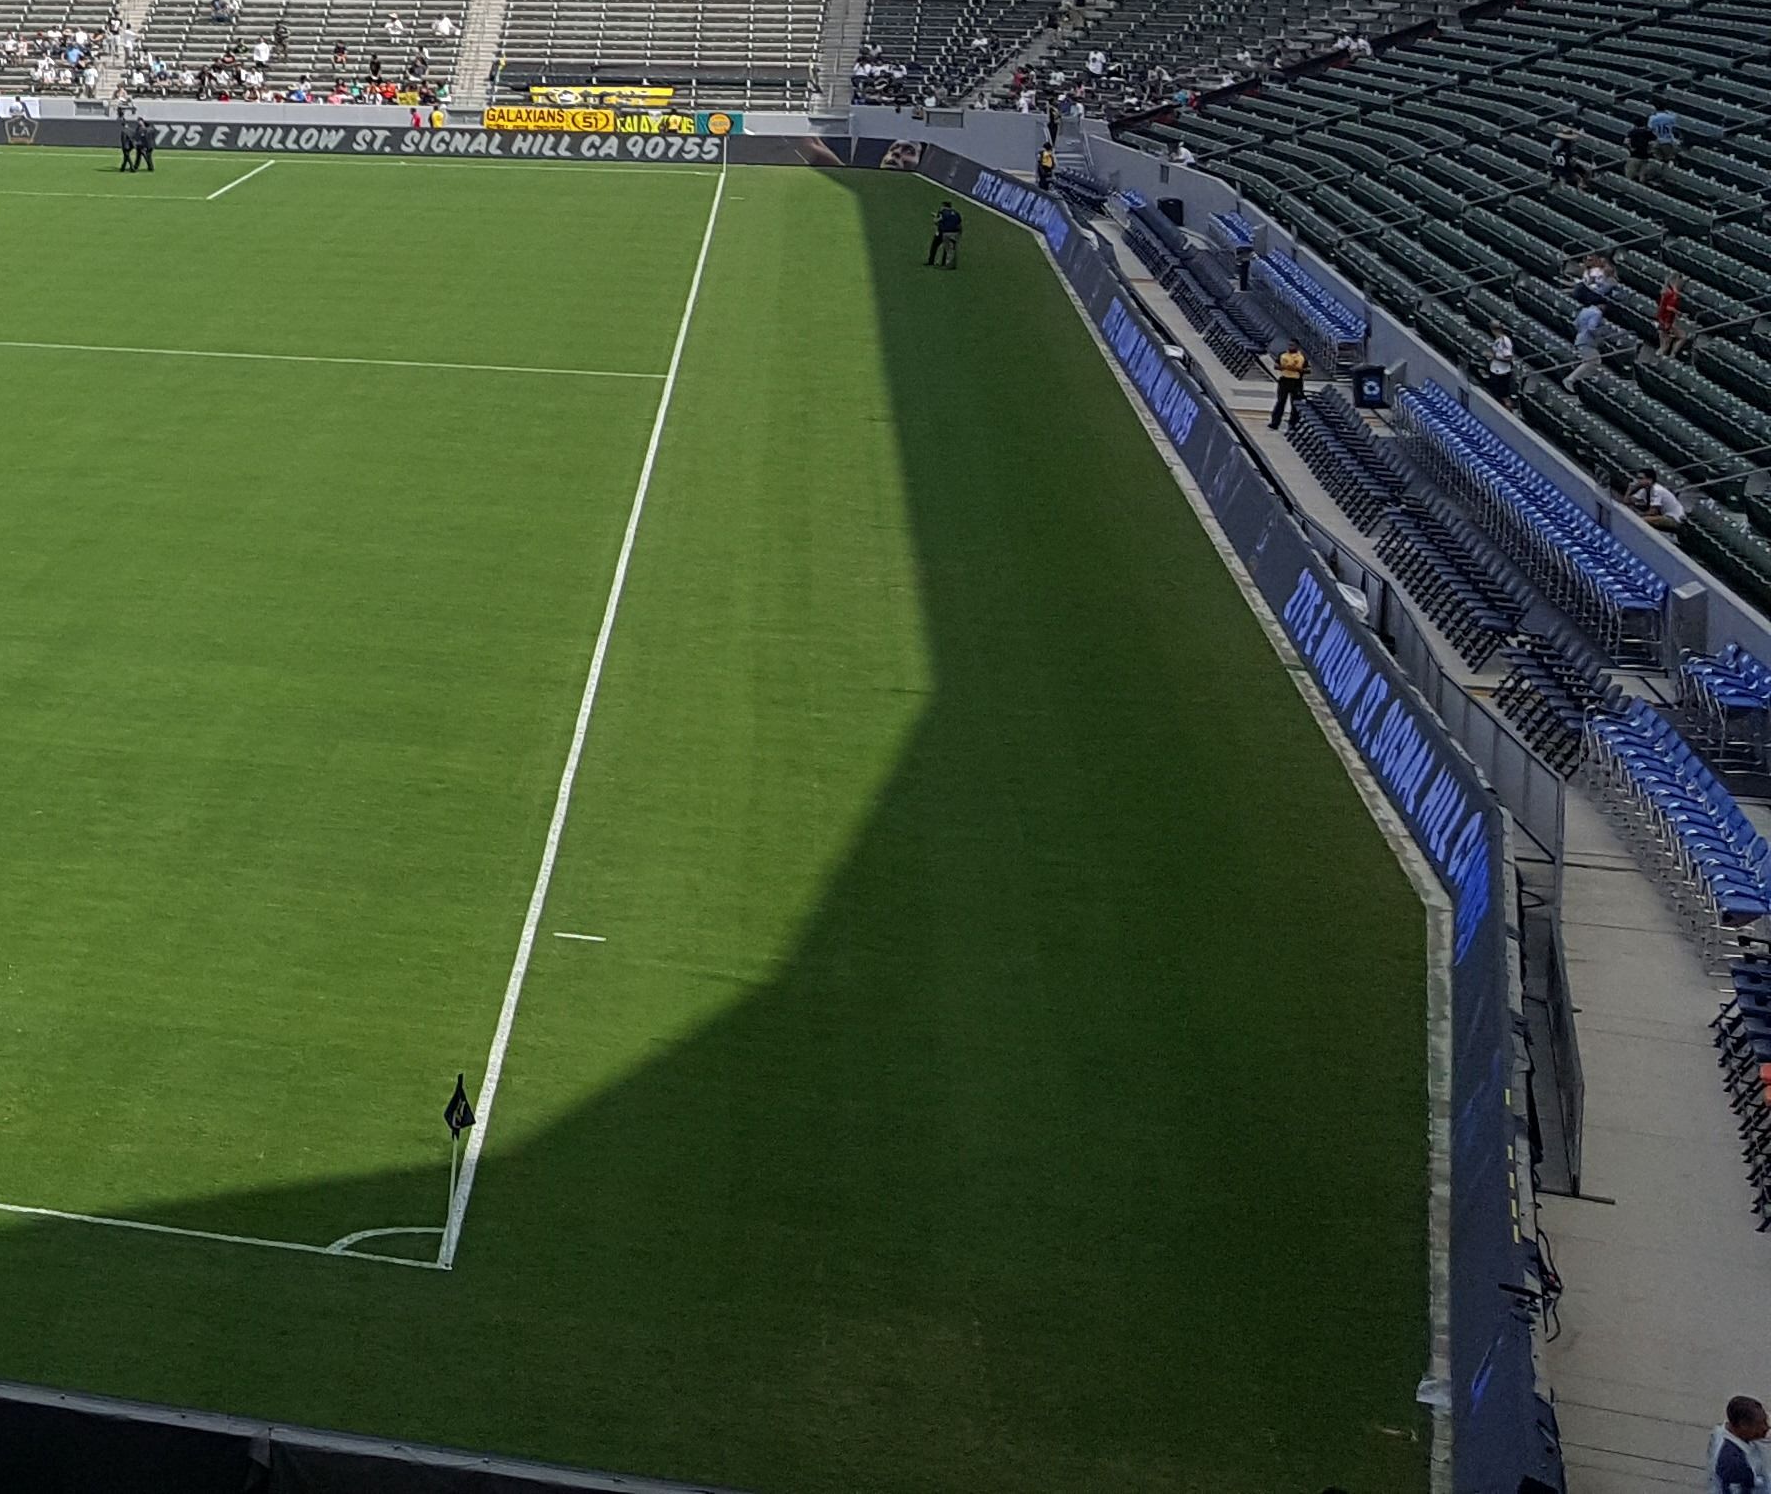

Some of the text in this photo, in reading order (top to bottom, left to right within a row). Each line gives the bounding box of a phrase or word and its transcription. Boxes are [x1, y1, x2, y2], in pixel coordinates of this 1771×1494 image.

[486, 108, 565, 124] GALAXIANS
[582, 116, 599, 129] 51
[152, 124, 721, 161] 775 E WILLOW ST. SIGNAL HILL CA 90755
